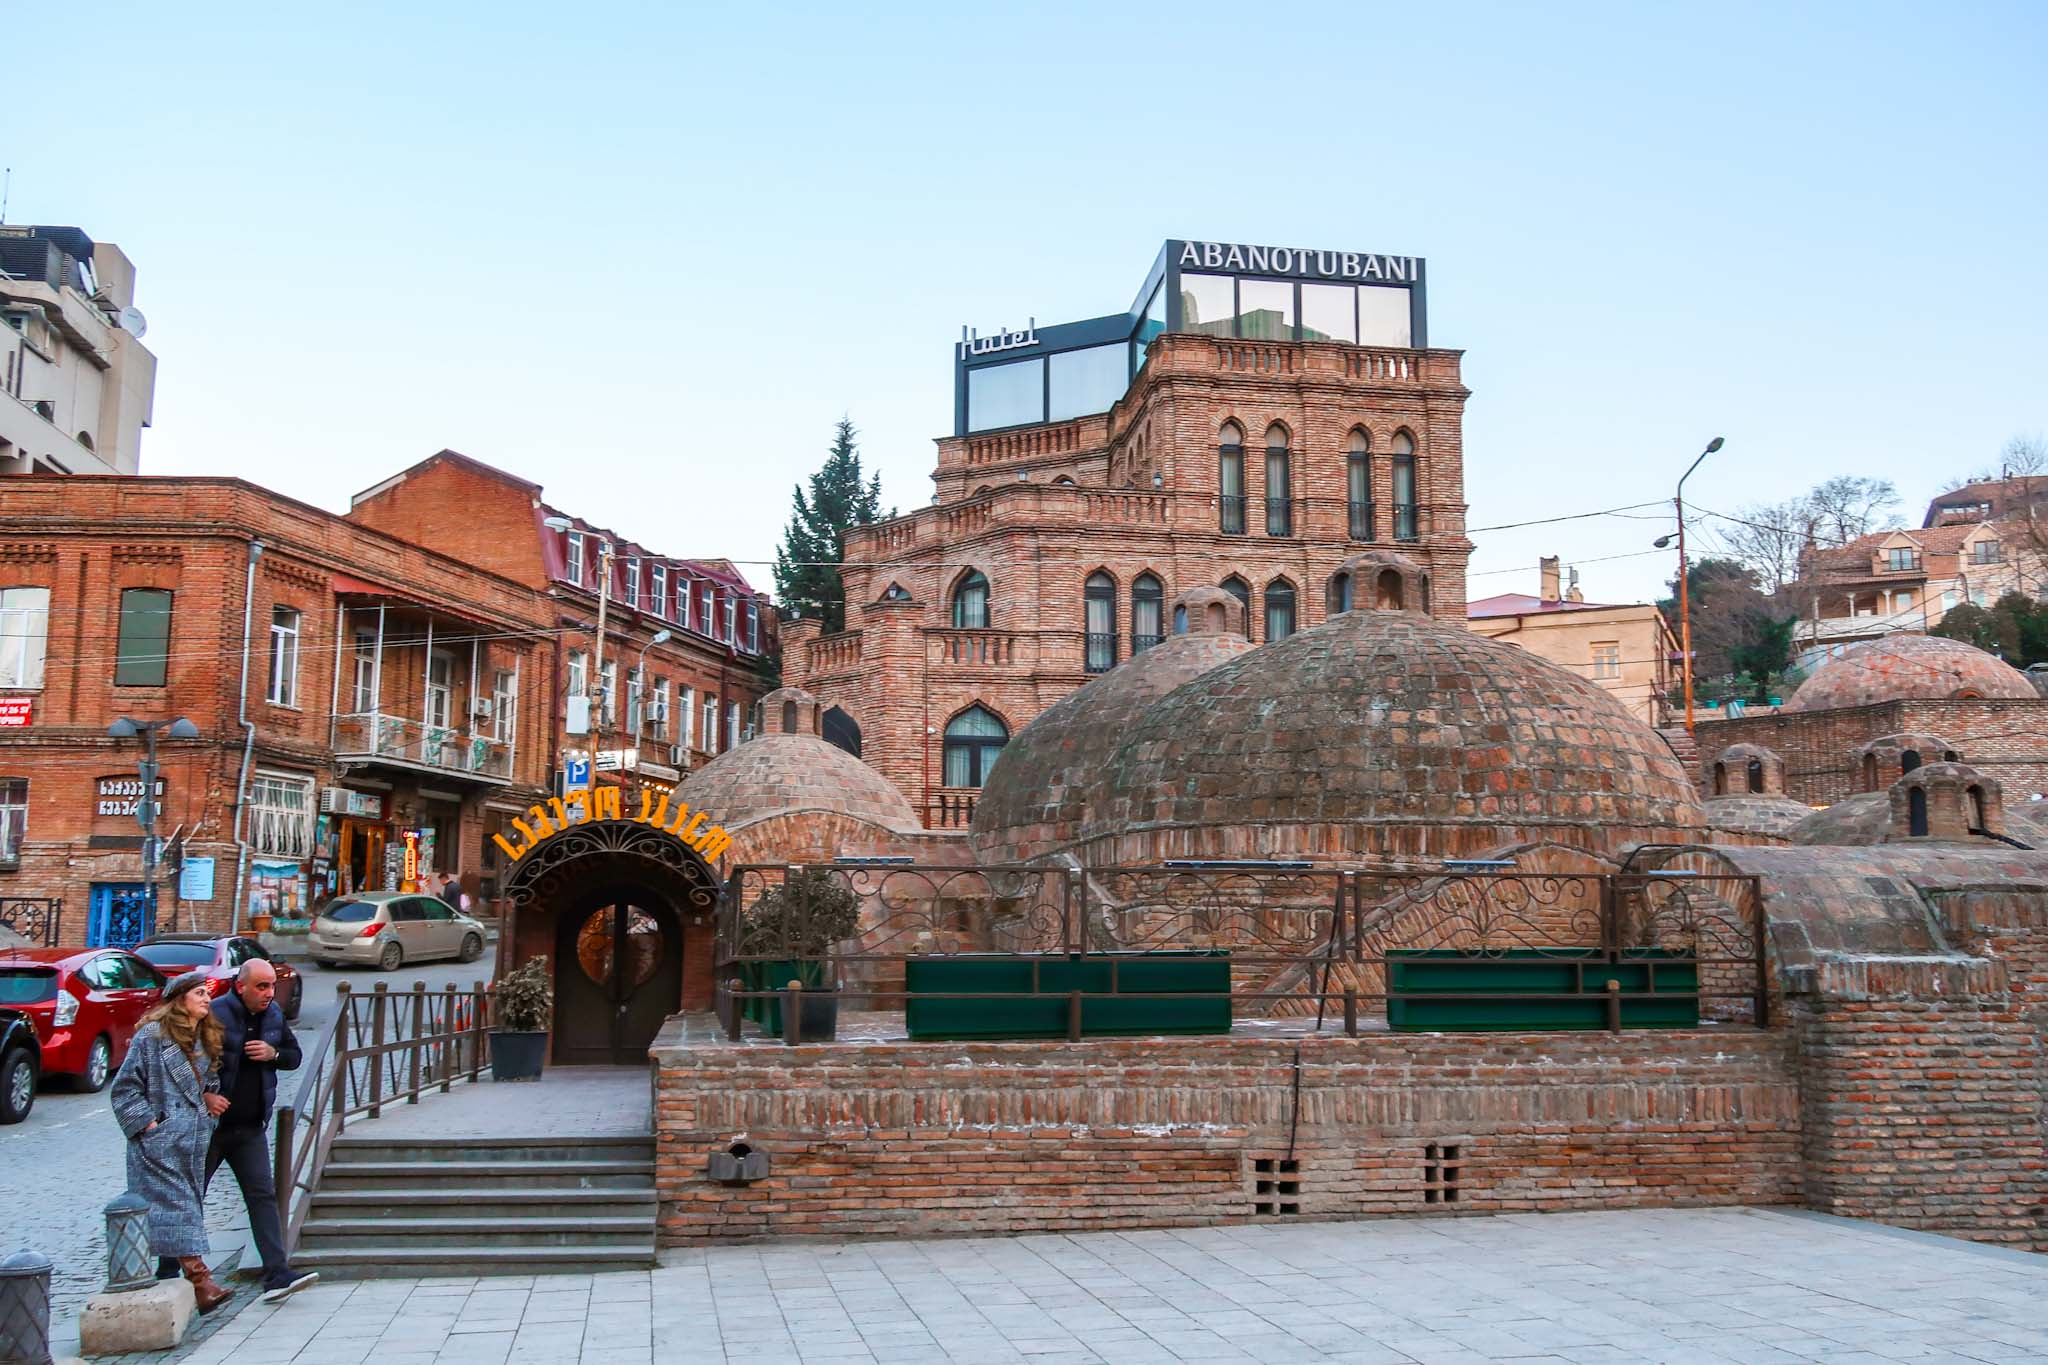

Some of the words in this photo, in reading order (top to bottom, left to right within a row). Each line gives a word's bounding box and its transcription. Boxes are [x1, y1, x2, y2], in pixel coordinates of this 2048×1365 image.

[1179, 241, 1418, 281] ABANOTUBANI
[961, 316, 1040, 361] Hotel
[572, 763, 587, 782] P
[100, 781, 163, 796] ხაჭაპუი
[99, 800, 162, 815] ჩებური
[491, 786, 622, 862] სამეფო
[633, 788, 733, 865] აბანო
